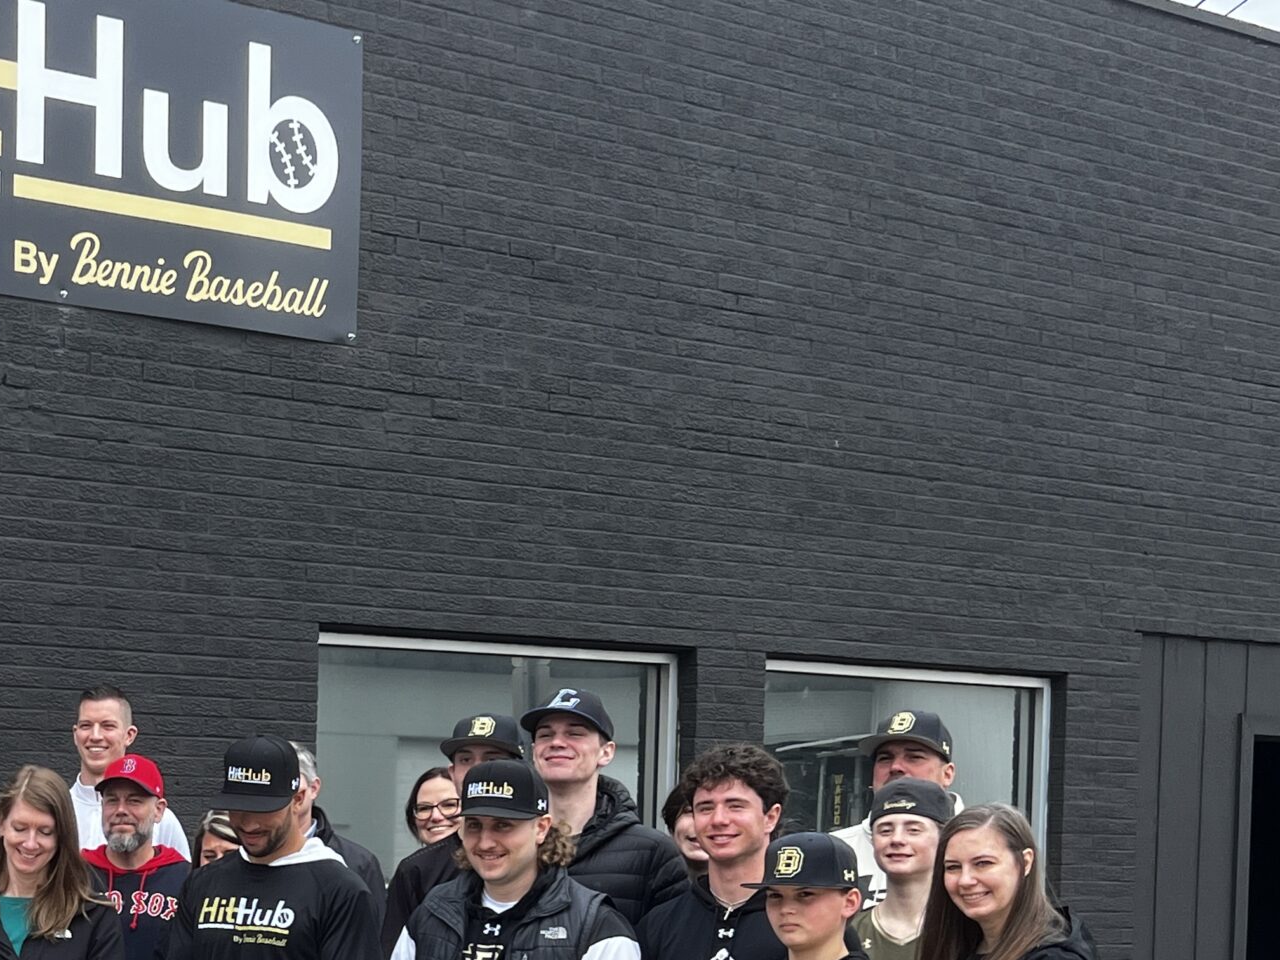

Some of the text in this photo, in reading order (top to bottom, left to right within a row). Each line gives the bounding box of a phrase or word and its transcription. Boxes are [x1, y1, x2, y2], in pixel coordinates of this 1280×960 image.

[14, 231, 329, 317] By Bennie Baseball
[228, 765, 271, 783] HitHub
[467, 781, 514, 796] HitHub
[199, 896, 295, 928] HitHub
